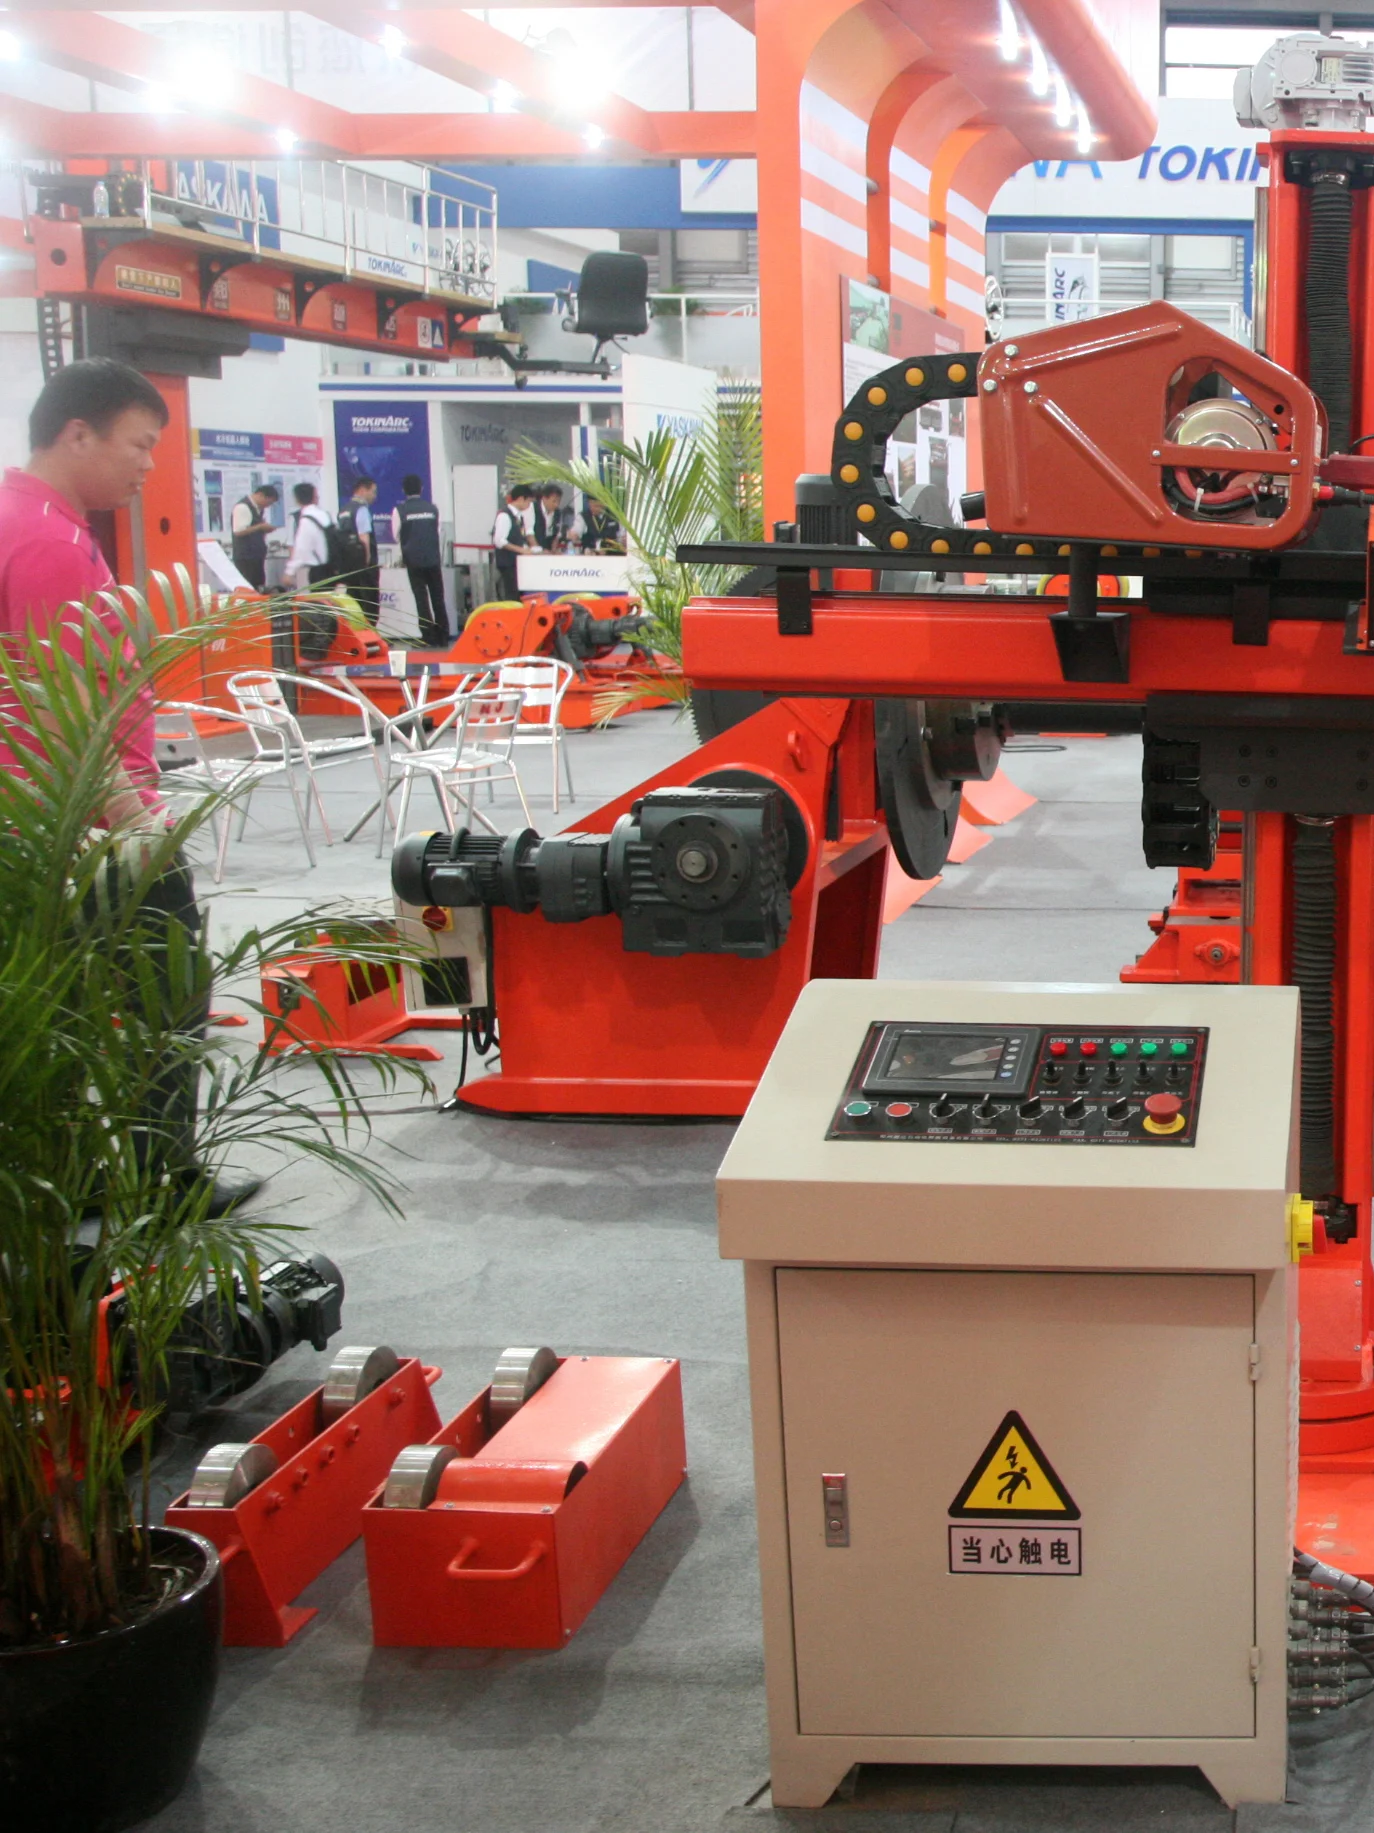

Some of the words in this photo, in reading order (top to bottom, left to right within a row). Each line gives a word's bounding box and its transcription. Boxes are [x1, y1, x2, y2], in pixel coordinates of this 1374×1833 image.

[177, 172, 269, 223] ASKAWA
[1054, 267, 1066, 320] INARC
[352, 415, 410, 428] TOKINARC
[549, 567, 601, 578] TOKINARC
[962, 1536, 1071, 1566] 当心触电
